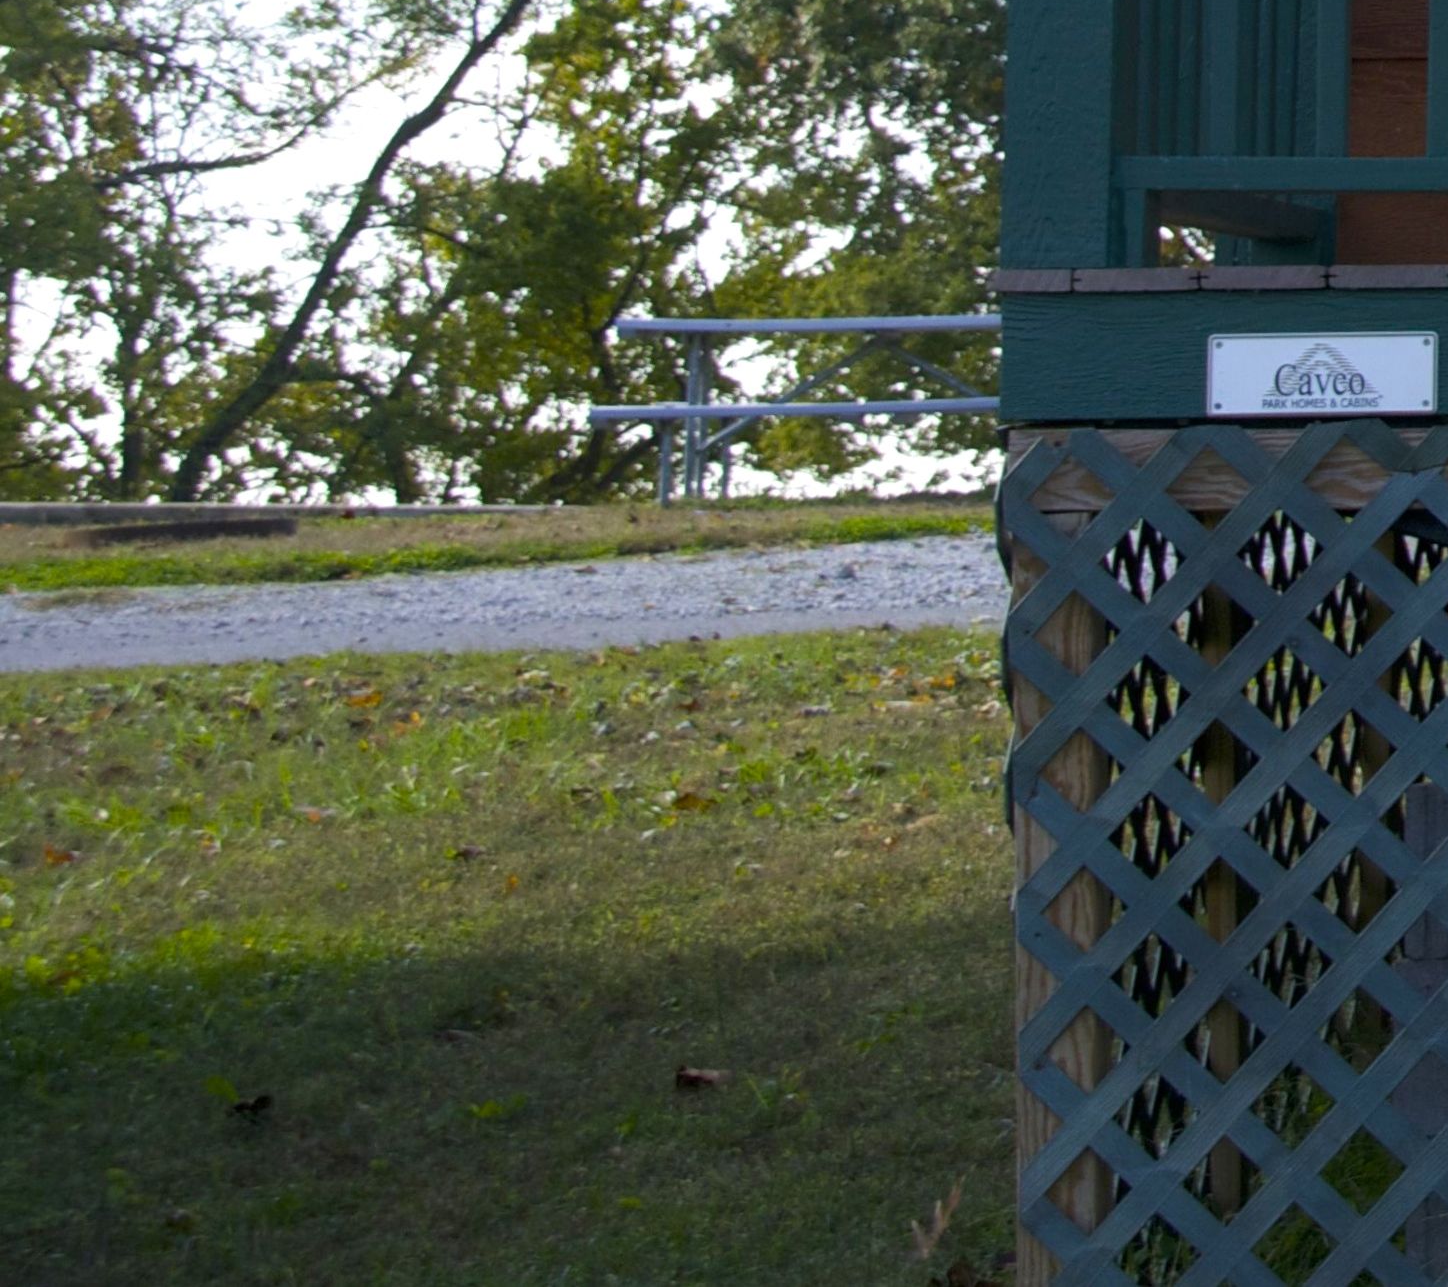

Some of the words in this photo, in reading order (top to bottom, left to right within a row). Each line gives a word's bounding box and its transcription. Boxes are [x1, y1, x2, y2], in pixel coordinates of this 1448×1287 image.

[1275, 363, 1365, 397] Cavco
[1261, 398, 1288, 409] PARK
[1291, 398, 1327, 408] HOMES
[1330, 397, 1337, 408] &
[1340, 397, 1379, 407] CABINS
